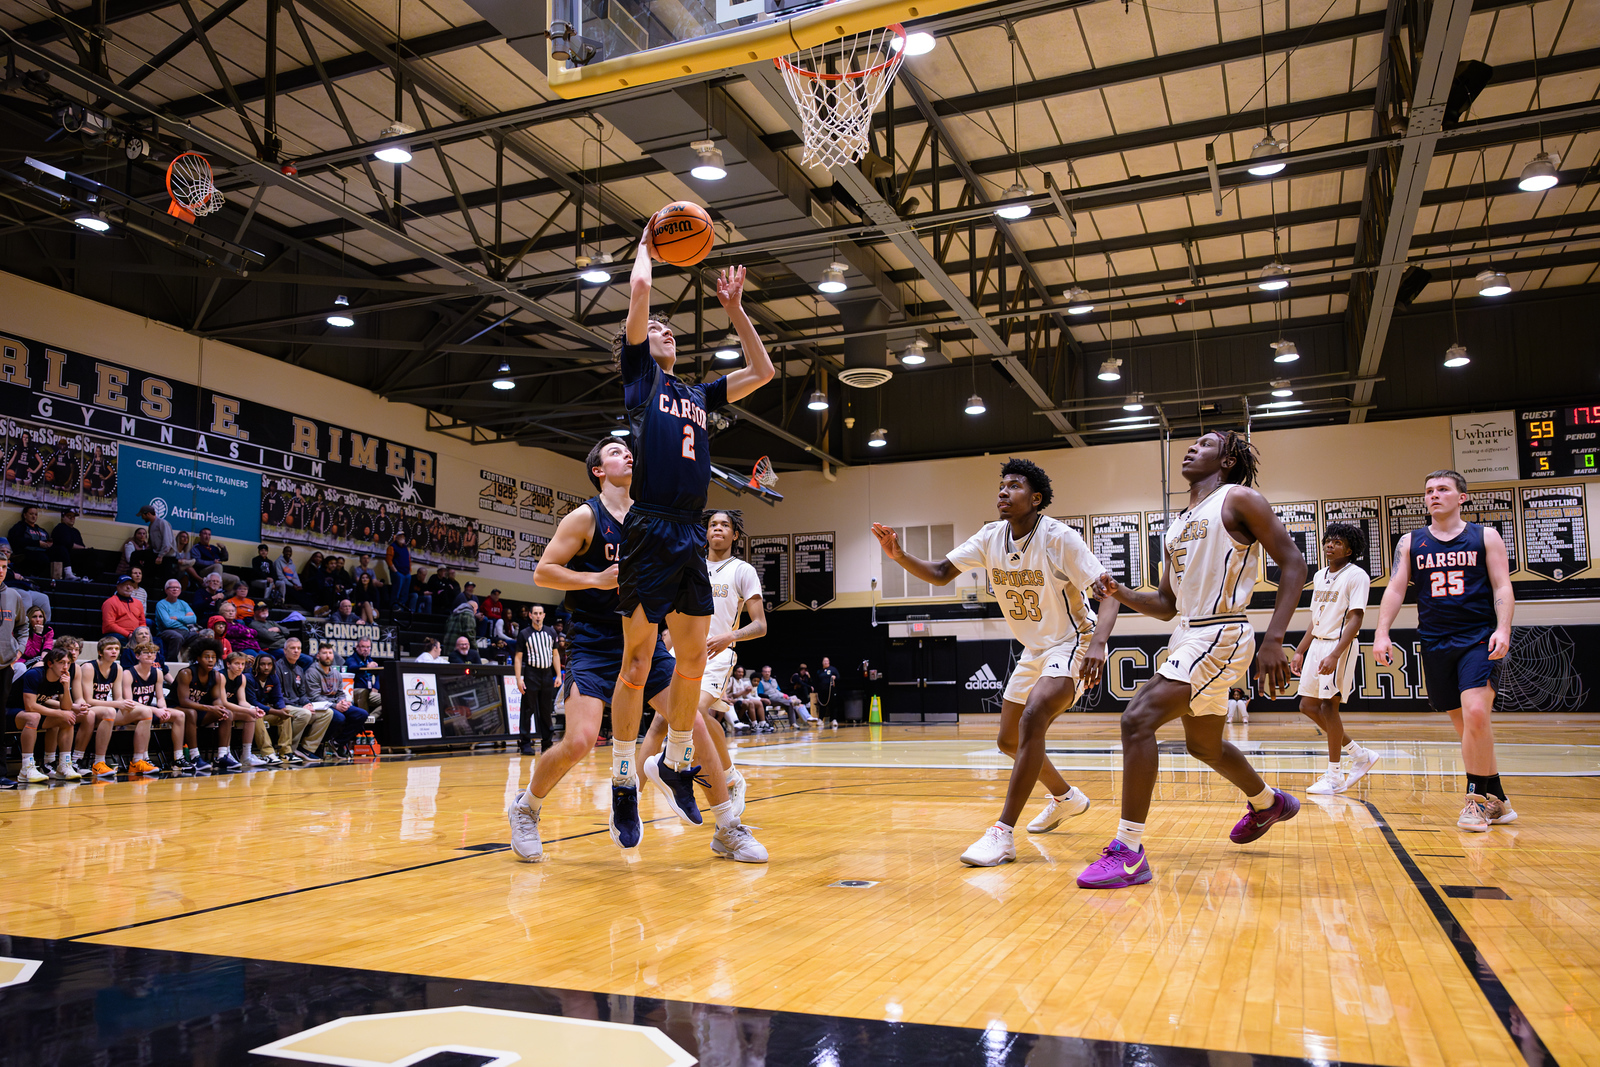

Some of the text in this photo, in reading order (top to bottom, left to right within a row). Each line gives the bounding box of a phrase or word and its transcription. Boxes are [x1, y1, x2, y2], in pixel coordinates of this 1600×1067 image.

[654, 220, 693, 237] Wilson
[659, 393, 707, 431] CARSON
[1522, 410, 1556, 420] GUEST
[1455, 427, 1513, 441] Uwharrie
[1530, 421, 1554, 439] 59
[1565, 432, 1596, 441] PERIOD
[9, 421, 117, 457] SPIERS SPERS SPIERS
[37, 397, 324, 478] GYMNASIUM
[210, 394, 249, 440] E.
[291, 415, 435, 486] RIMER
[682, 424, 696, 461] 2
[1470, 438, 1498, 446] BANK
[1539, 457, 1549, 470] 5
[1584, 454, 1594, 467] 0
[136, 459, 249, 489] CERTIFIED ATHLETIC TRAINERS
[1463, 466, 1509, 474] uwharrie.com
[482, 471, 515, 486] FOOTBALL
[162, 478, 227, 496] Are Proudly Provided By
[493, 483, 513, 499] 1929
[522, 482, 552, 496] FOOTBALL
[1523, 487, 1582, 501] CONCORD
[532, 493, 550, 508] 2004
[1389, 497, 1426, 509] CONCO
[1464, 491, 1511, 502] ONCORD
[1528, 498, 1578, 508] WRESTLING
[480, 499, 517, 516] STATE CHAMPIONS
[1271, 503, 1315, 514] ONCORD
[1325, 500, 1378, 513] CONCORD
[1392, 507, 1430, 516] BASKETB
[1525, 507, 1583, 519] 100 CAREER WINS
[171, 505, 235, 526] Atrium Health
[520, 509, 532, 519] STATE
[532, 511, 554, 524] CHAMPIONS
[1092, 514, 1139, 527] CONCORD
[1328, 511, 1376, 520] BASKETBALL
[1479, 511, 1513, 522] POINTS
[481, 525, 513, 538] FOOTBALL
[1094, 525, 1137, 534] BASKETBALL
[1285, 522, 1315, 532] POINTS
[492, 536, 512, 551] 1935
[751, 537, 788, 547] CONCORD
[795, 534, 833, 544] CONCORD
[531, 543, 544, 557] 200
[799, 543, 829, 551] FOOTBALL
[479, 552, 516, 568] STATE CHAMPIONS
[519, 559, 531, 569] STATE
[1416, 551, 1478, 570] CARSON
[992, 567, 1045, 588] SPIDERS
[1430, 570, 1465, 597] 25
[1005, 589, 1042, 622] 33
[325, 622, 380, 641] CONCORD
[965, 680, 1003, 690] adidas
